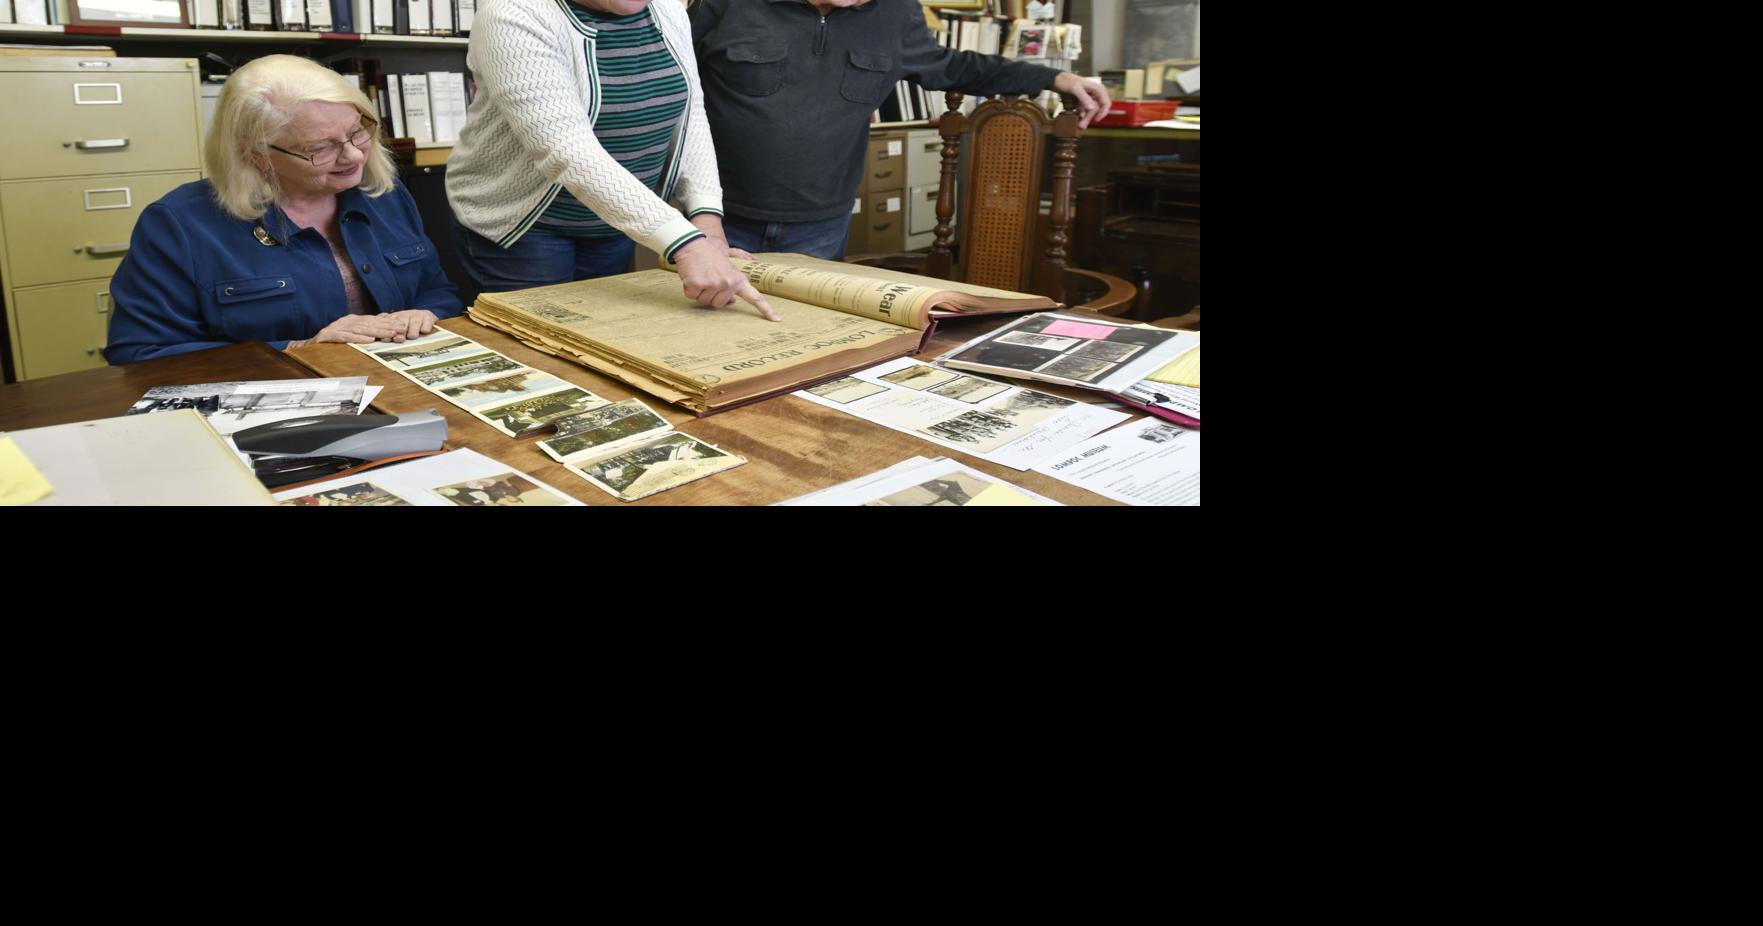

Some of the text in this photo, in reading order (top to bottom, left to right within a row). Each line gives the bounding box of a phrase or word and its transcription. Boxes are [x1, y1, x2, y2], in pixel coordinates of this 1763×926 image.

[878, 285, 913, 318] Wear
[803, 329, 876, 350] LOMPOC
[722, 349, 803, 372] RECORD
